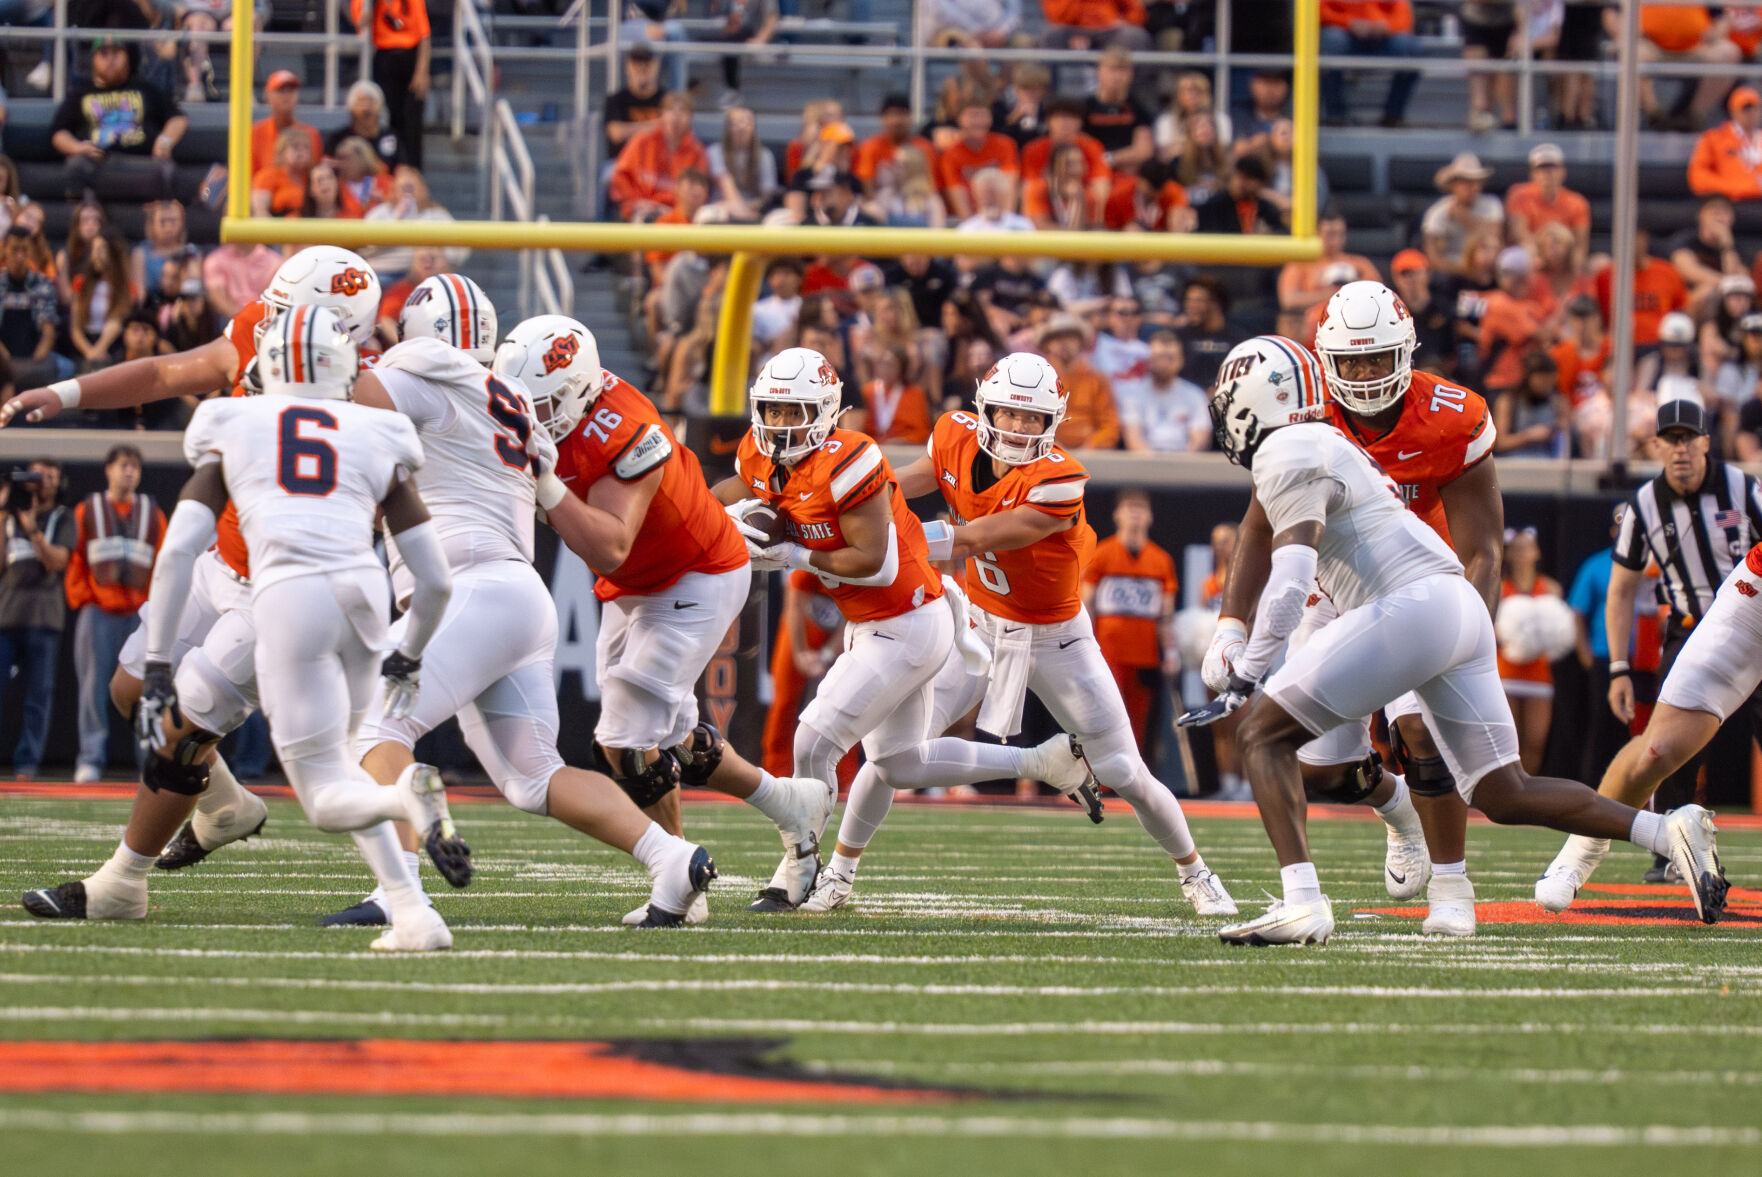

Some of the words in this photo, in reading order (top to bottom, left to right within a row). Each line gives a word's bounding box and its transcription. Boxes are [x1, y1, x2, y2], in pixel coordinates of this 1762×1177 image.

[1350, 338, 1375, 346] COWBOYS
[769, 387, 791, 395] COWBOYS
[1009, 393, 1033, 403] COWBOYS
[1429, 384, 1467, 413] 70
[582, 408, 623, 444] 76
[277, 405, 339, 497] 6
[800, 521, 835, 540] STATE
